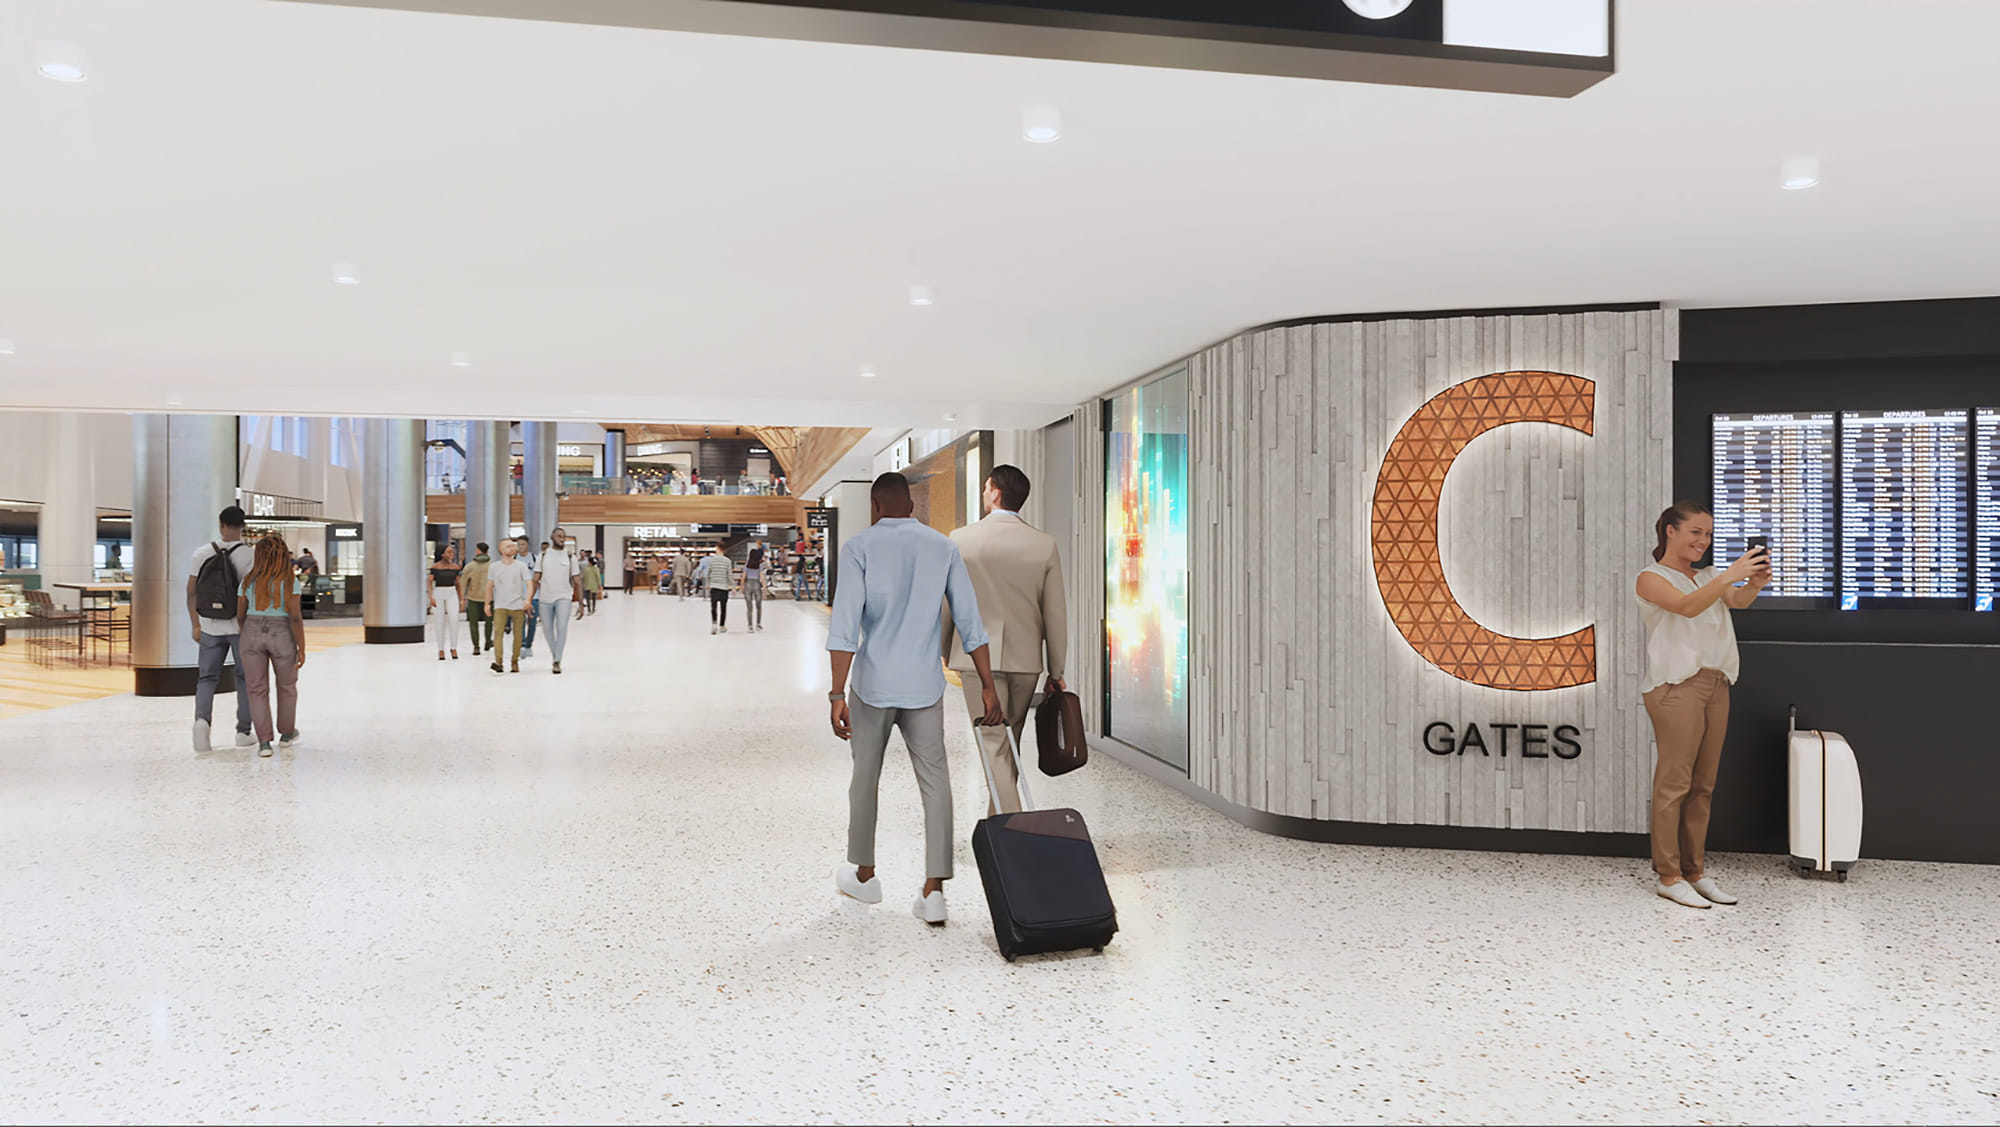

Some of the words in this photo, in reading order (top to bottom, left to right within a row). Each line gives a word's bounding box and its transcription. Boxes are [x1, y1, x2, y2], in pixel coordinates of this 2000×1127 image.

[253, 494, 275, 516] BAR
[633, 526, 681, 538] RETAIL
[1371, 370, 1596, 691] C
[1423, 722, 1582, 760] GATES
